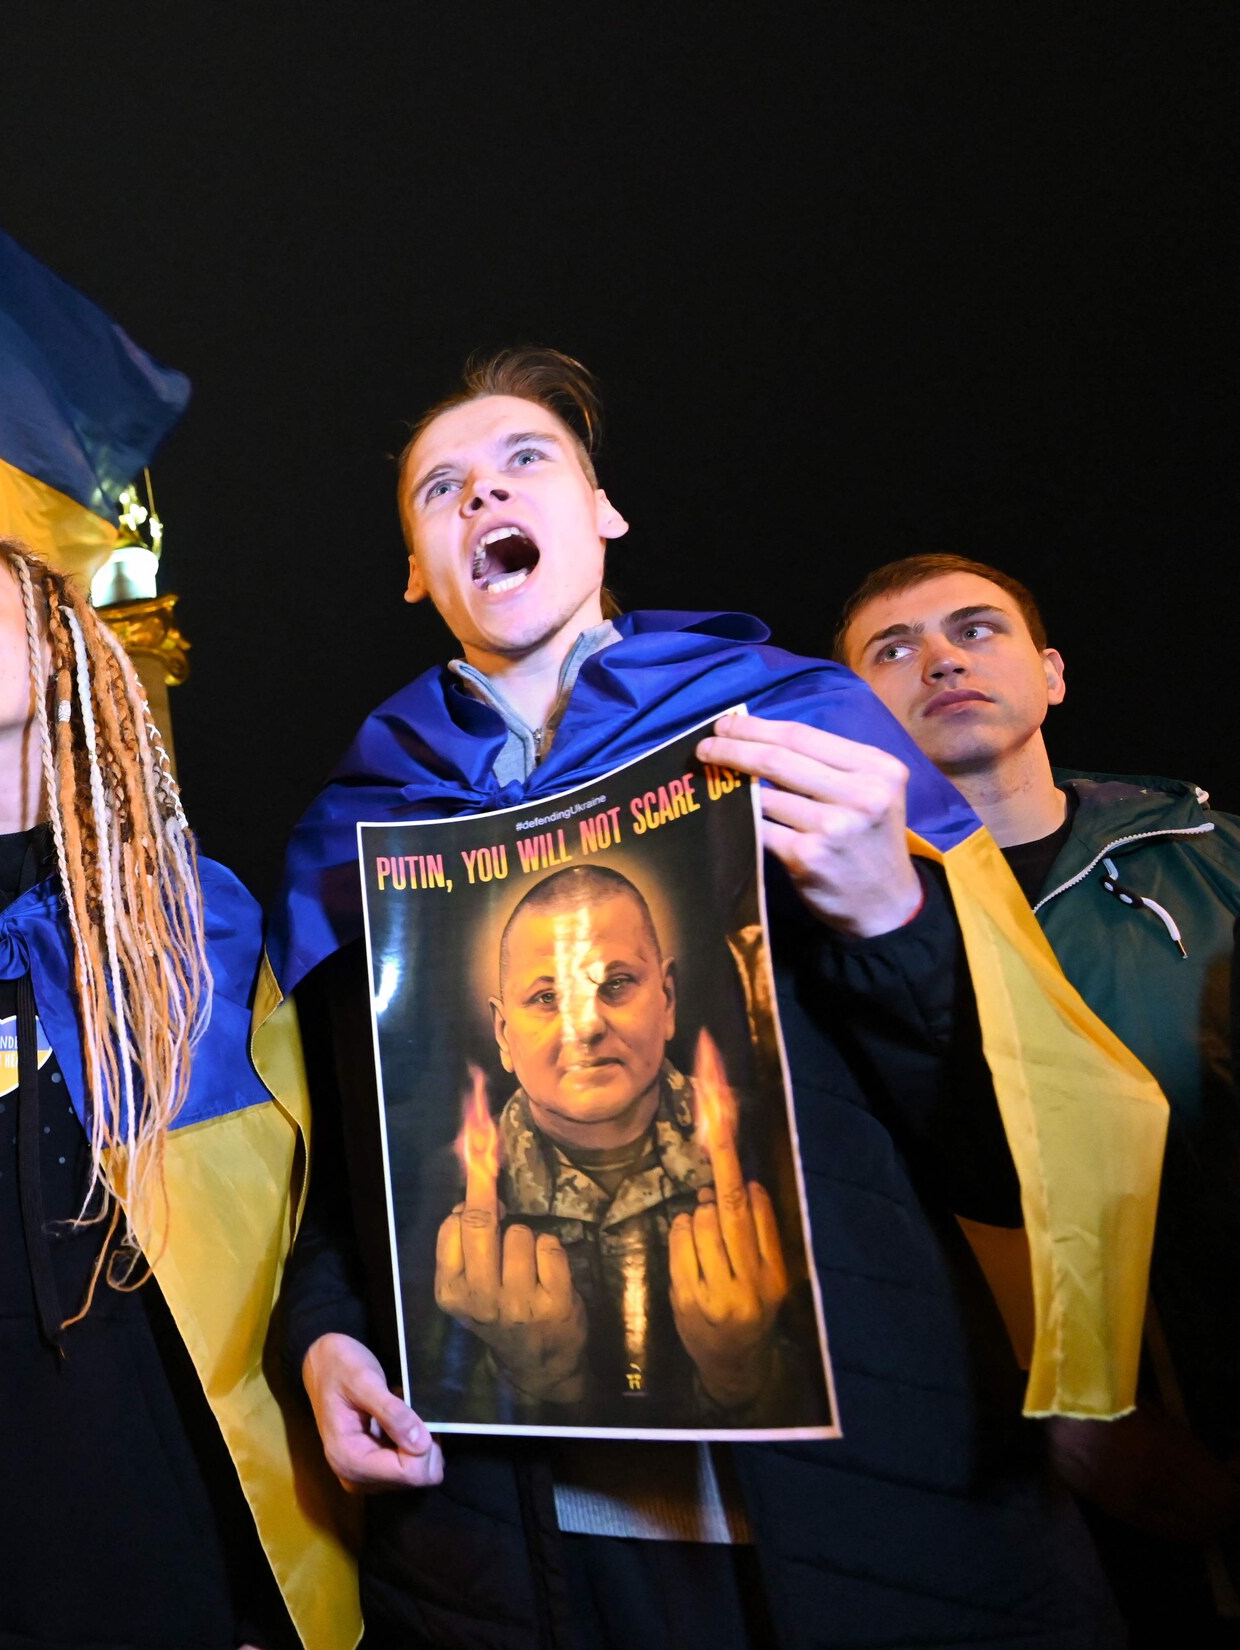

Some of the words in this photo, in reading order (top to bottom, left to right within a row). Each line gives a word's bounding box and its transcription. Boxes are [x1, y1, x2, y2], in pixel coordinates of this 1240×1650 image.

[376, 854, 453, 893] PUTIN,
[461, 844, 509, 884] YOU
[516, 829, 573, 873] WILL
[579, 806, 622, 855] NOT
[629, 772, 701, 835] SCARE
[515, 794, 607, 832] #defendingUkraine
